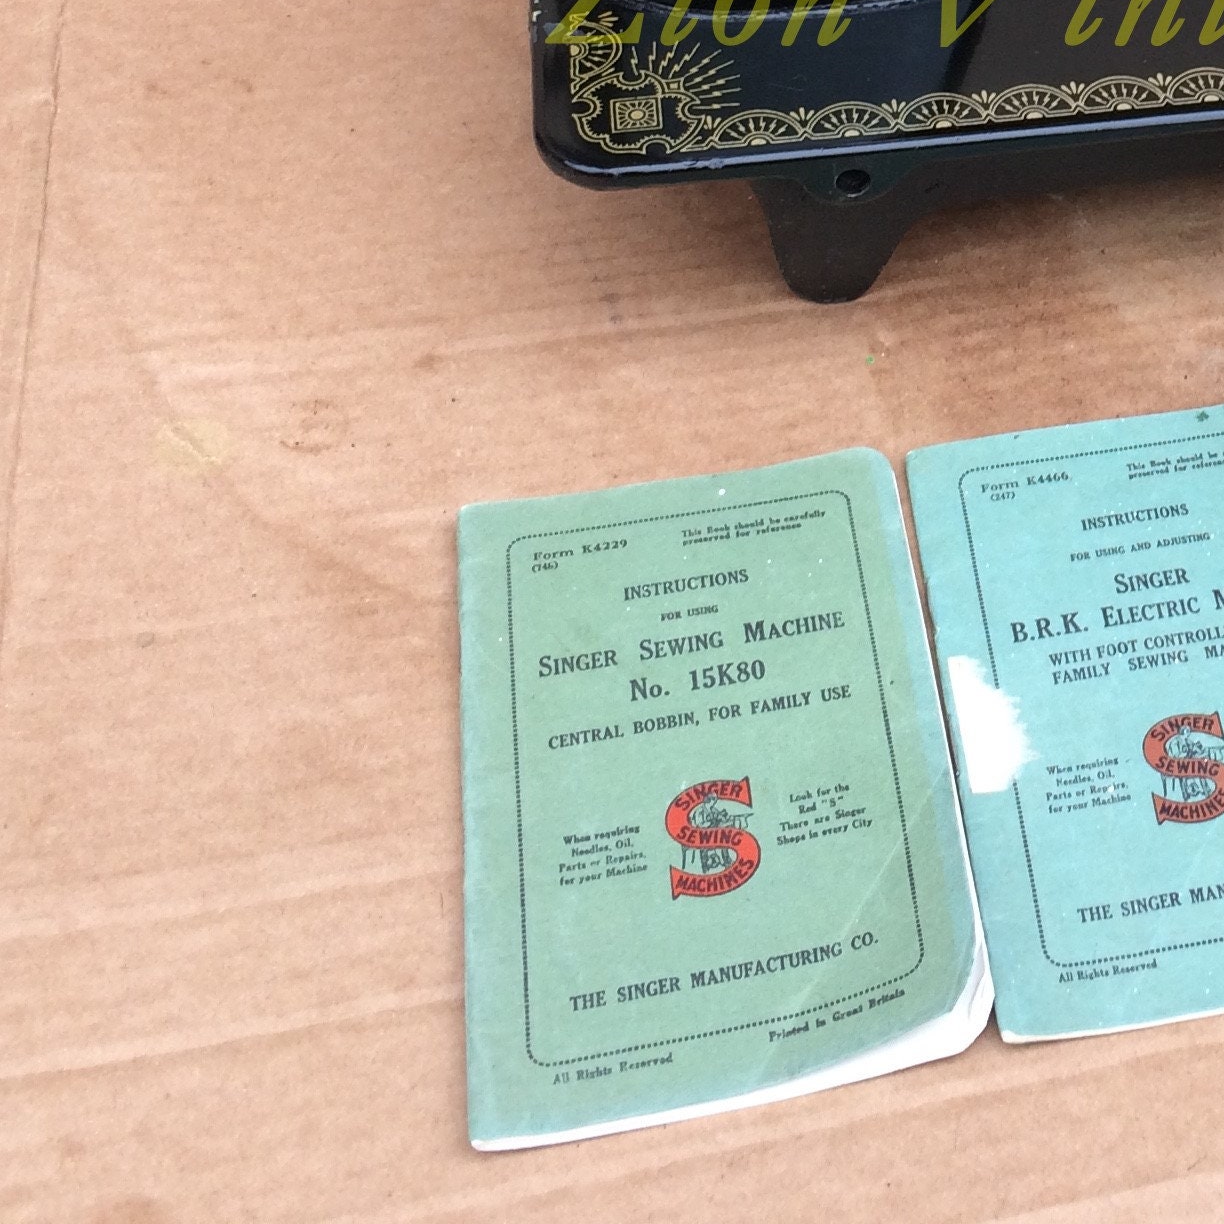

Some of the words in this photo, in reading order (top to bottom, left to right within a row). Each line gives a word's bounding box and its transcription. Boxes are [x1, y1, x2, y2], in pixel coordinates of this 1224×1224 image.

[1127, 462, 1145, 472] This
[1150, 458, 1172, 468] Book
[1176, 454, 1203, 465] should
[1207, 451, 1219, 459] be
[1173, 464, 1188, 472] for
[981, 481, 1019, 493] Form
[990, 492, 1016, 501] (247)
[1081, 504, 1189, 531] INSTRUCTIONS
[682, 528, 701, 538] This
[735, 529, 751, 538] for
[533, 547, 575, 562] Form
[582, 539, 628, 554] K4229
[1070, 551, 1091, 562] FOR
[1095, 546, 1127, 559] USING
[1130, 541, 1152, 552] AND
[1156, 532, 1211, 549] ADJUSTING
[623, 569, 749, 601] INSTRUCTIONS
[1113, 567, 1190, 595] SINGER
[660, 611, 682, 621] FOR
[687, 604, 719, 618] USING
[1010, 612, 1089, 644] B.R.K.
[1101, 597, 1201, 631] ELECTRIC
[538, 648, 618, 678] SINGER
[639, 631, 724, 661] SEWING
[743, 611, 845, 645] MACHINE
[1048, 647, 1092, 667] WITH
[1096, 639, 1138, 660] FOOT
[1052, 662, 1112, 685] FAMILY
[1127, 650, 1189, 672] SEWING
[630, 677, 671, 702] No.
[688, 660, 766, 692] 15K80
[548, 724, 625, 751] CENTRAL
[632, 711, 701, 734] BOBBIN,
[708, 703, 742, 721] FOR
[750, 691, 812, 715] FAMILY
[821, 684, 852, 701] USE
[1150, 717, 1214, 742] SINGER
[1046, 763, 1073, 776] When
[1076, 756, 1119, 771] requiring
[1155, 756, 1219, 776] SEWING
[816, 787, 831, 798] for
[834, 783, 850, 794] the
[1056, 775, 1094, 787] Needles,
[674, 781, 743, 812] SINGER
[1046, 789, 1072, 801] Parts
[1048, 804, 1063, 814] for
[1067, 800, 1088, 813] your
[1092, 792, 1131, 806] Machine
[779, 818, 809, 831] There
[835, 806, 866, 821] Singer
[798, 803, 817, 814] Red
[594, 824, 641, 840] requiring
[676, 827, 743, 846] SEWING
[777, 832, 805, 846] Shops
[809, 831, 818, 839] in
[821, 823, 849, 837] every
[852, 817, 873, 831] City
[559, 860, 586, 873] Parts
[559, 876, 575, 886] for
[578, 872, 602, 884] your
[606, 863, 648, 878] Machine
[676, 858, 755, 893] MACHINES
[1077, 903, 1113, 924] THE
[1121, 891, 1182, 916] SINGER
[569, 990, 607, 1012] THE
[617, 976, 681, 1003] SINGER
[690, 942, 842, 989] MANUFACTURING
[849, 932, 878, 951] CO.
[1058, 972, 1073, 983] All
[1077, 965, 1110, 981] Rights
[1112, 958, 1158, 973] Reserved
[769, 1022, 809, 1043] Printed
[814, 1017, 827, 1027] in
[832, 1004, 863, 1023] Great
[868, 988, 905, 1010] Britain
[553, 1072, 571, 1085] All
[576, 1065, 613, 1083] Rights
[618, 1053, 674, 1073] Reserved
